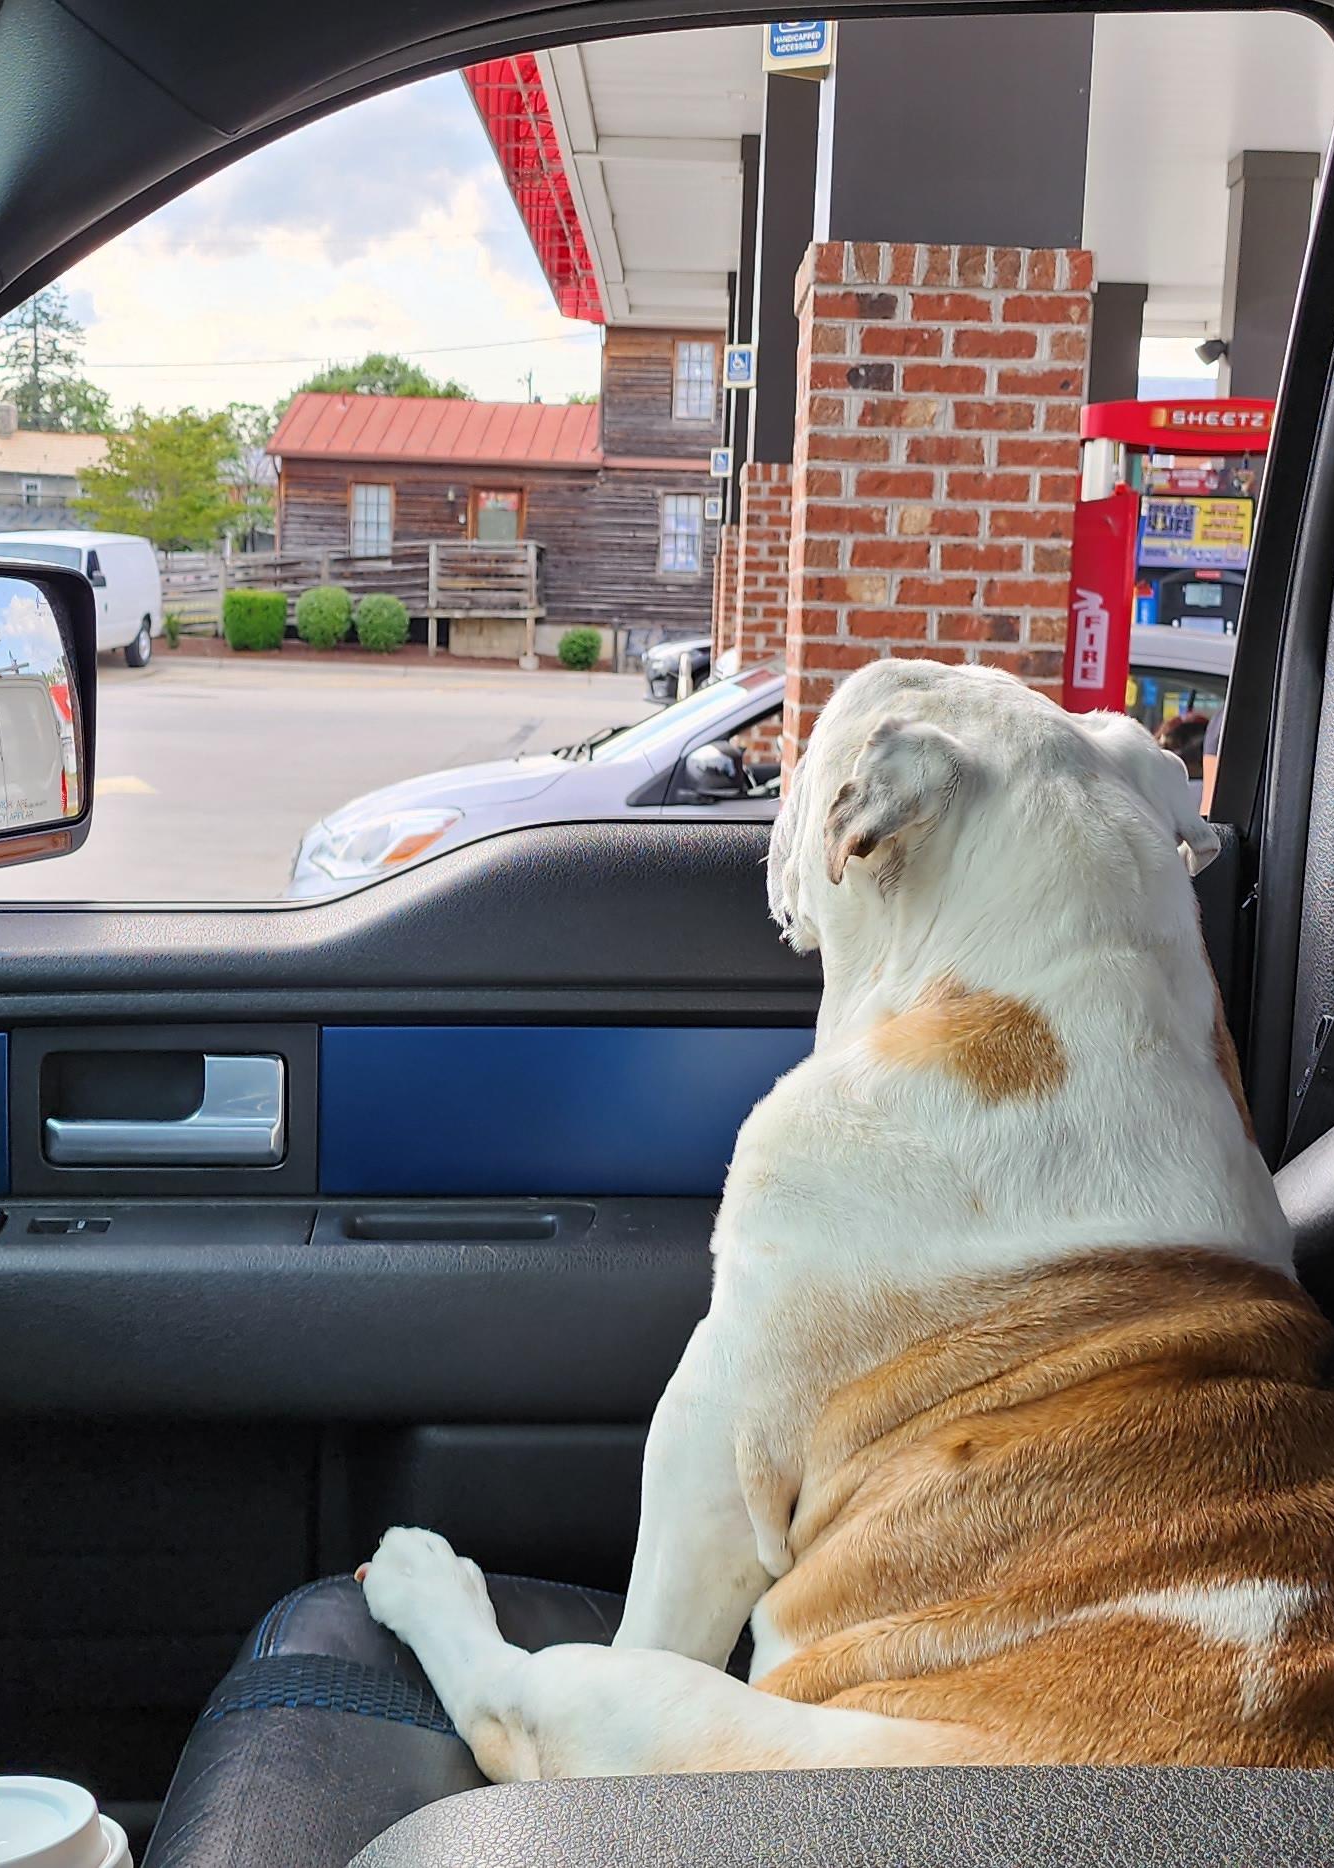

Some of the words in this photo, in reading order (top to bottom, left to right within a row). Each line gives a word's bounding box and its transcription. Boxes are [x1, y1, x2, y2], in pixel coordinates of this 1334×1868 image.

[773, 31, 821, 44] HANDICAPPED
[776, 41, 818, 53] ACCESSIBLE
[1172, 410, 1265, 427] SHEETZ
[1081, 616, 1101, 680] FIRE
